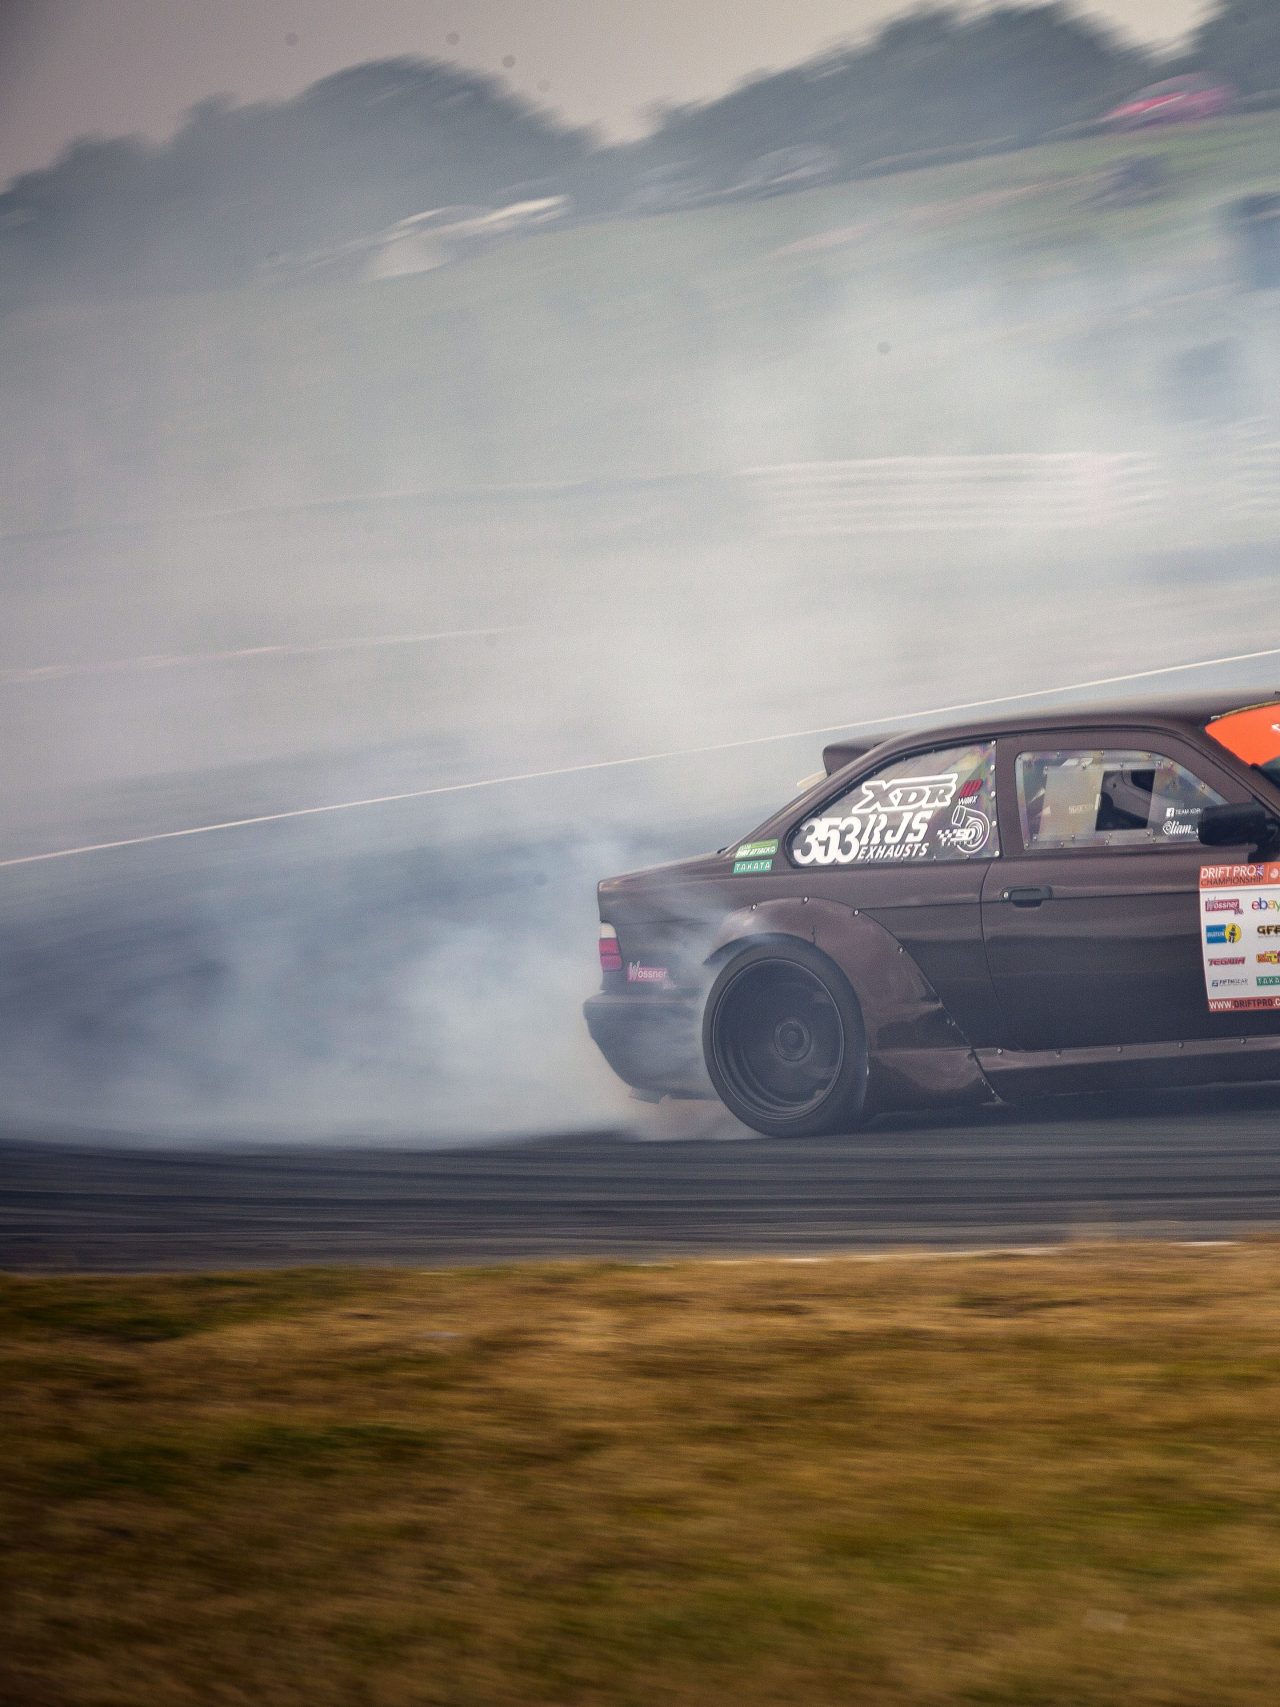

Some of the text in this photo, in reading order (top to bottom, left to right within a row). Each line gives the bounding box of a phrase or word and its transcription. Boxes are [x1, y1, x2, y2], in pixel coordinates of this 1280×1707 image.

[852, 773, 958, 814] XDR
[859, 810, 934, 846] RJS
[794, 816, 862, 864] 353
[857, 843, 929, 861] EXHAUSTS
[736, 862, 770, 871] TAKATA
[1201, 865, 1232, 879] DRIFT
[1233, 864, 1257, 877] PRO
[1201, 875, 1264, 887] CHAMPIONSHIP
